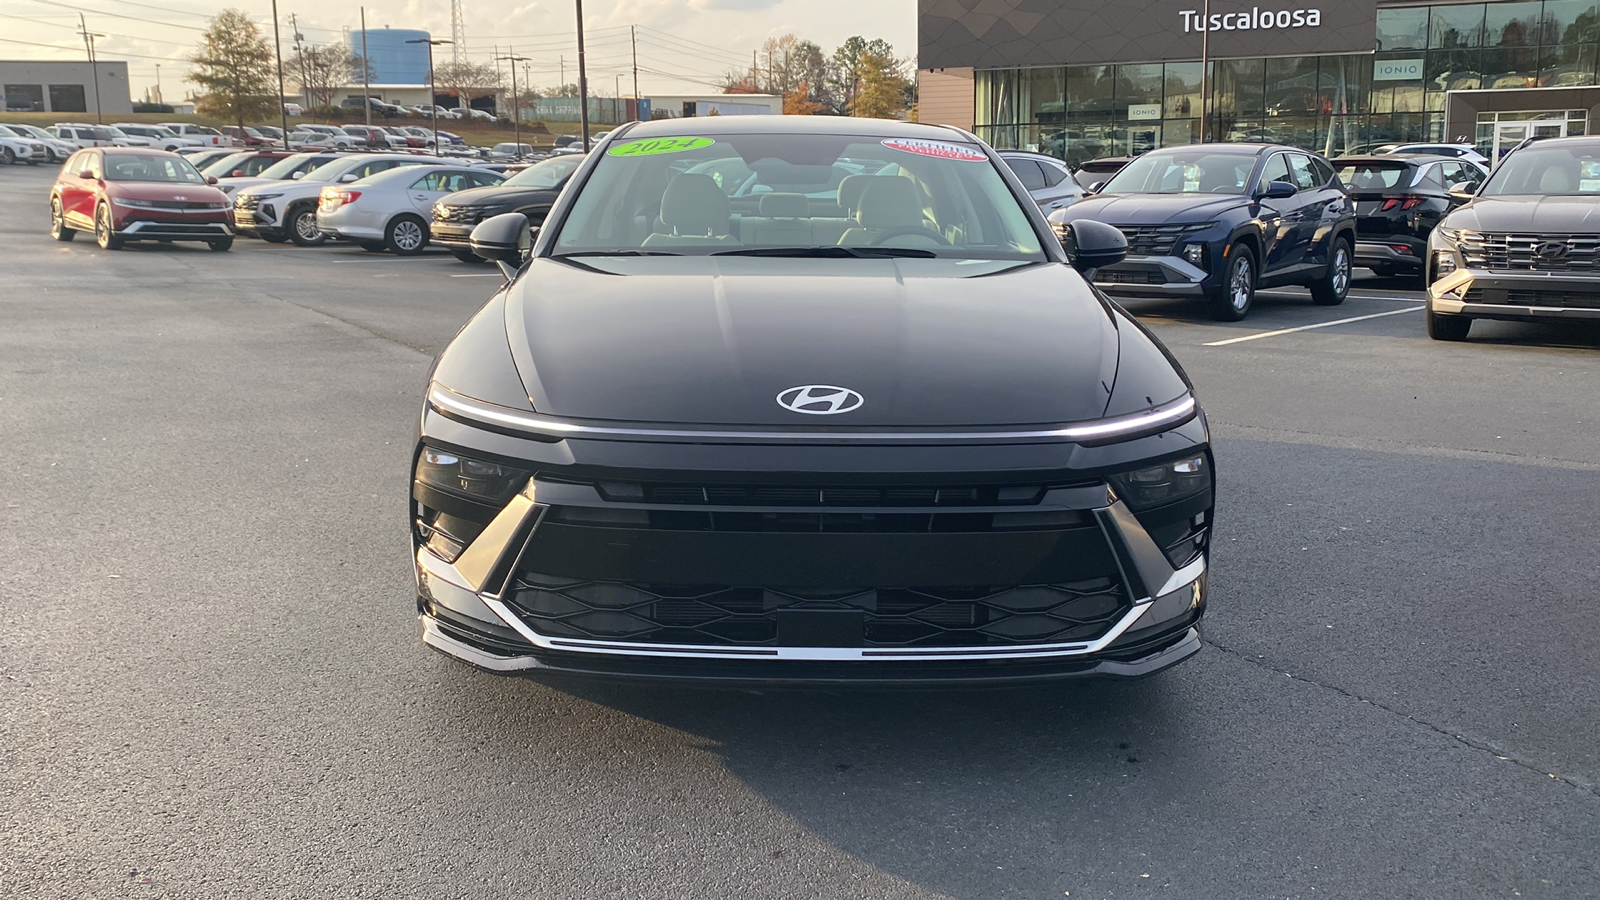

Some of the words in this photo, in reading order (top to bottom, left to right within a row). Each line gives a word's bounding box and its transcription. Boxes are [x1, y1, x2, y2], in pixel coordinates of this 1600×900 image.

[1179, 7, 1321, 33] Tuscaloosa
[621, 138, 698, 155] 2024
[894, 139, 977, 155] CERTIFIED
